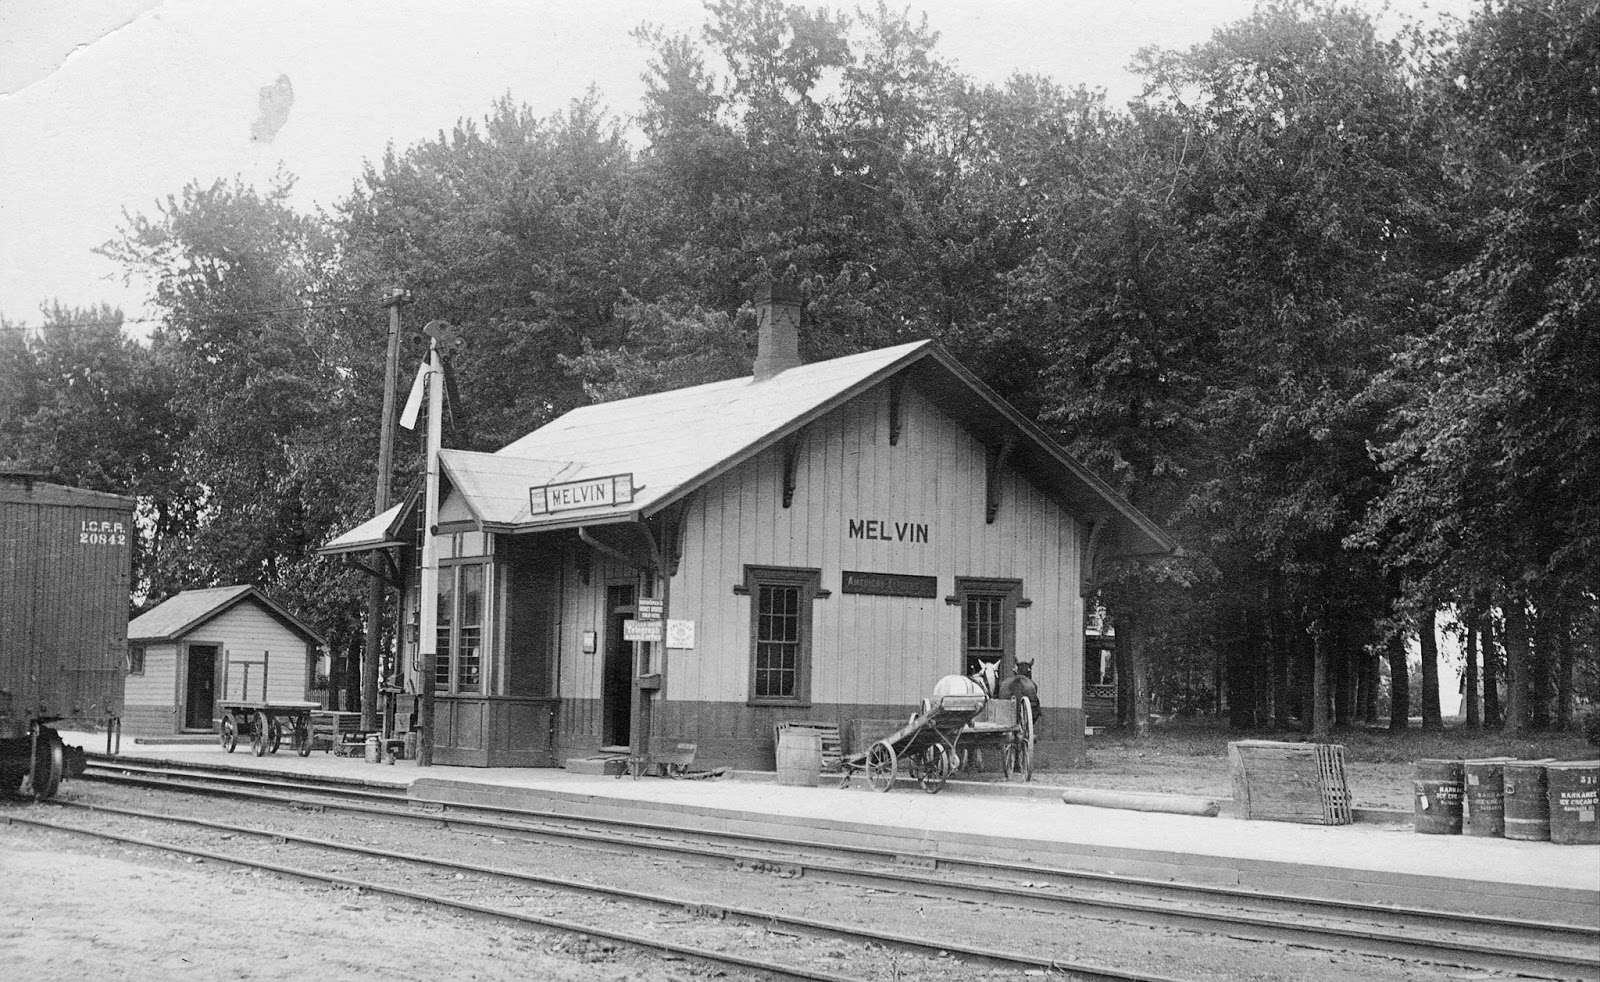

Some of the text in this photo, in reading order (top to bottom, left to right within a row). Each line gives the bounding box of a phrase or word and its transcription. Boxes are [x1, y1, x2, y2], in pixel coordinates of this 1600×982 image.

[552, 484, 605, 506] MELVIN
[79, 532, 126, 545] 20842
[849, 519, 928, 543] MELVIN
[626, 625, 660, 635] Telegraph
